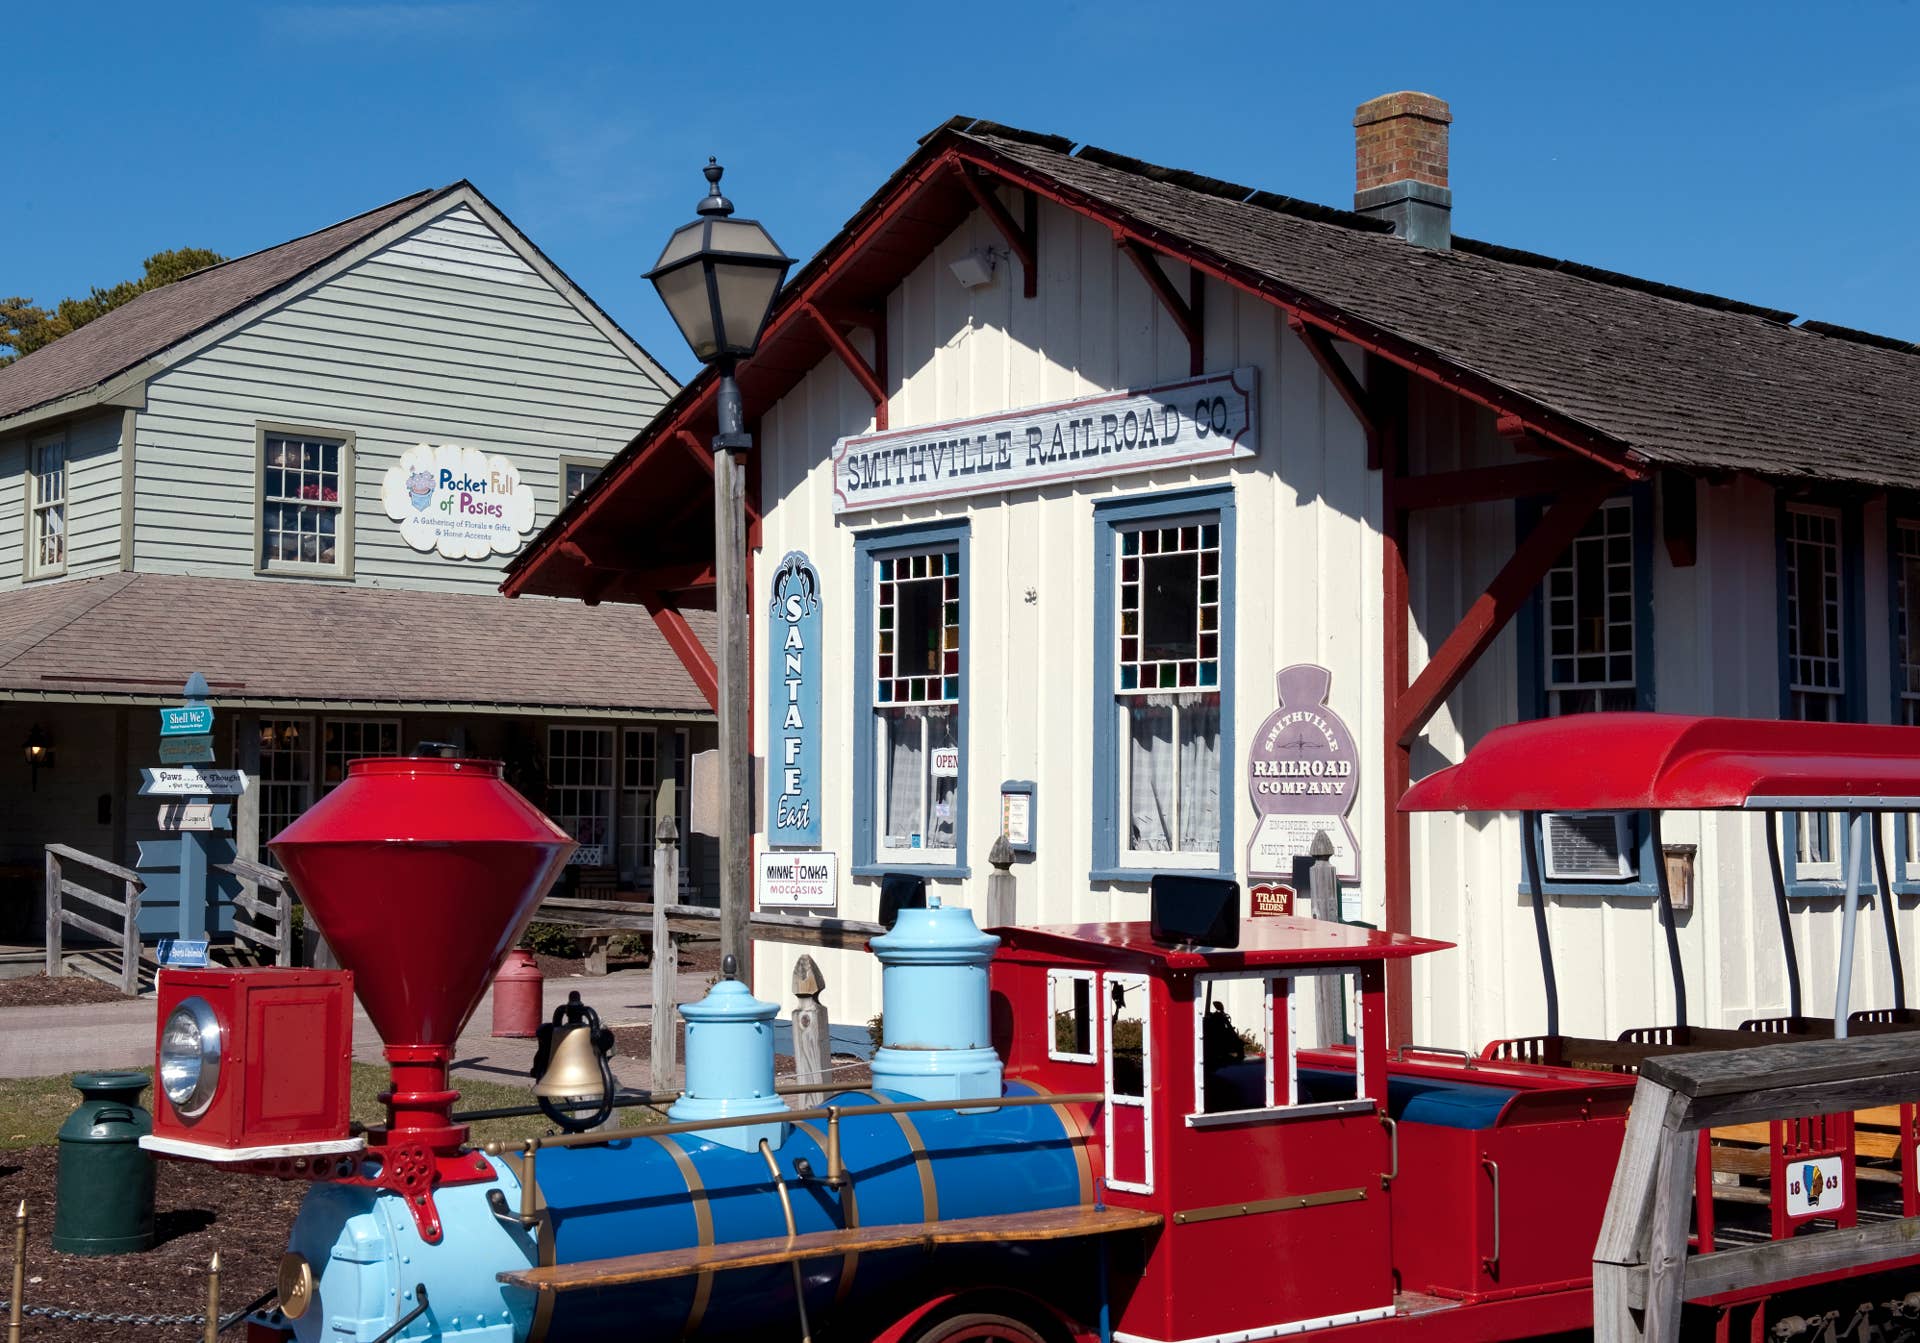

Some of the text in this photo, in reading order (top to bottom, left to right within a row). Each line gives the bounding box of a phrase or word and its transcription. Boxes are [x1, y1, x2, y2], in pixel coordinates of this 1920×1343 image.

[847, 395, 1231, 492] SMITHVILLE RAILROAD CO.
[439, 468, 513, 496] Pocket Full
[440, 492, 502, 518] of Posies
[412, 516, 511, 532] A Gathering of Florals Gifts
[435, 528, 492, 541] & Home Accents
[784, 594, 804, 796] SANTA FE
[170, 711, 205, 724] Shell We?
[1265, 711, 1339, 752] SMITHVILLE
[936, 755, 959, 768] OPEN
[1253, 760, 1351, 777] RAILROAD
[1258, 781, 1346, 795] COMPANY
[777, 793, 810, 830] East
[1261, 844, 1286, 856] NEXT
[767, 865, 828, 881] MINNETONKA
[770, 885, 824, 895] MOCCASINS
[1256, 892, 1288, 904] TRAIN
[1259, 903, 1284, 912] RIDES
[1789, 1175, 1838, 1196] 18 63
